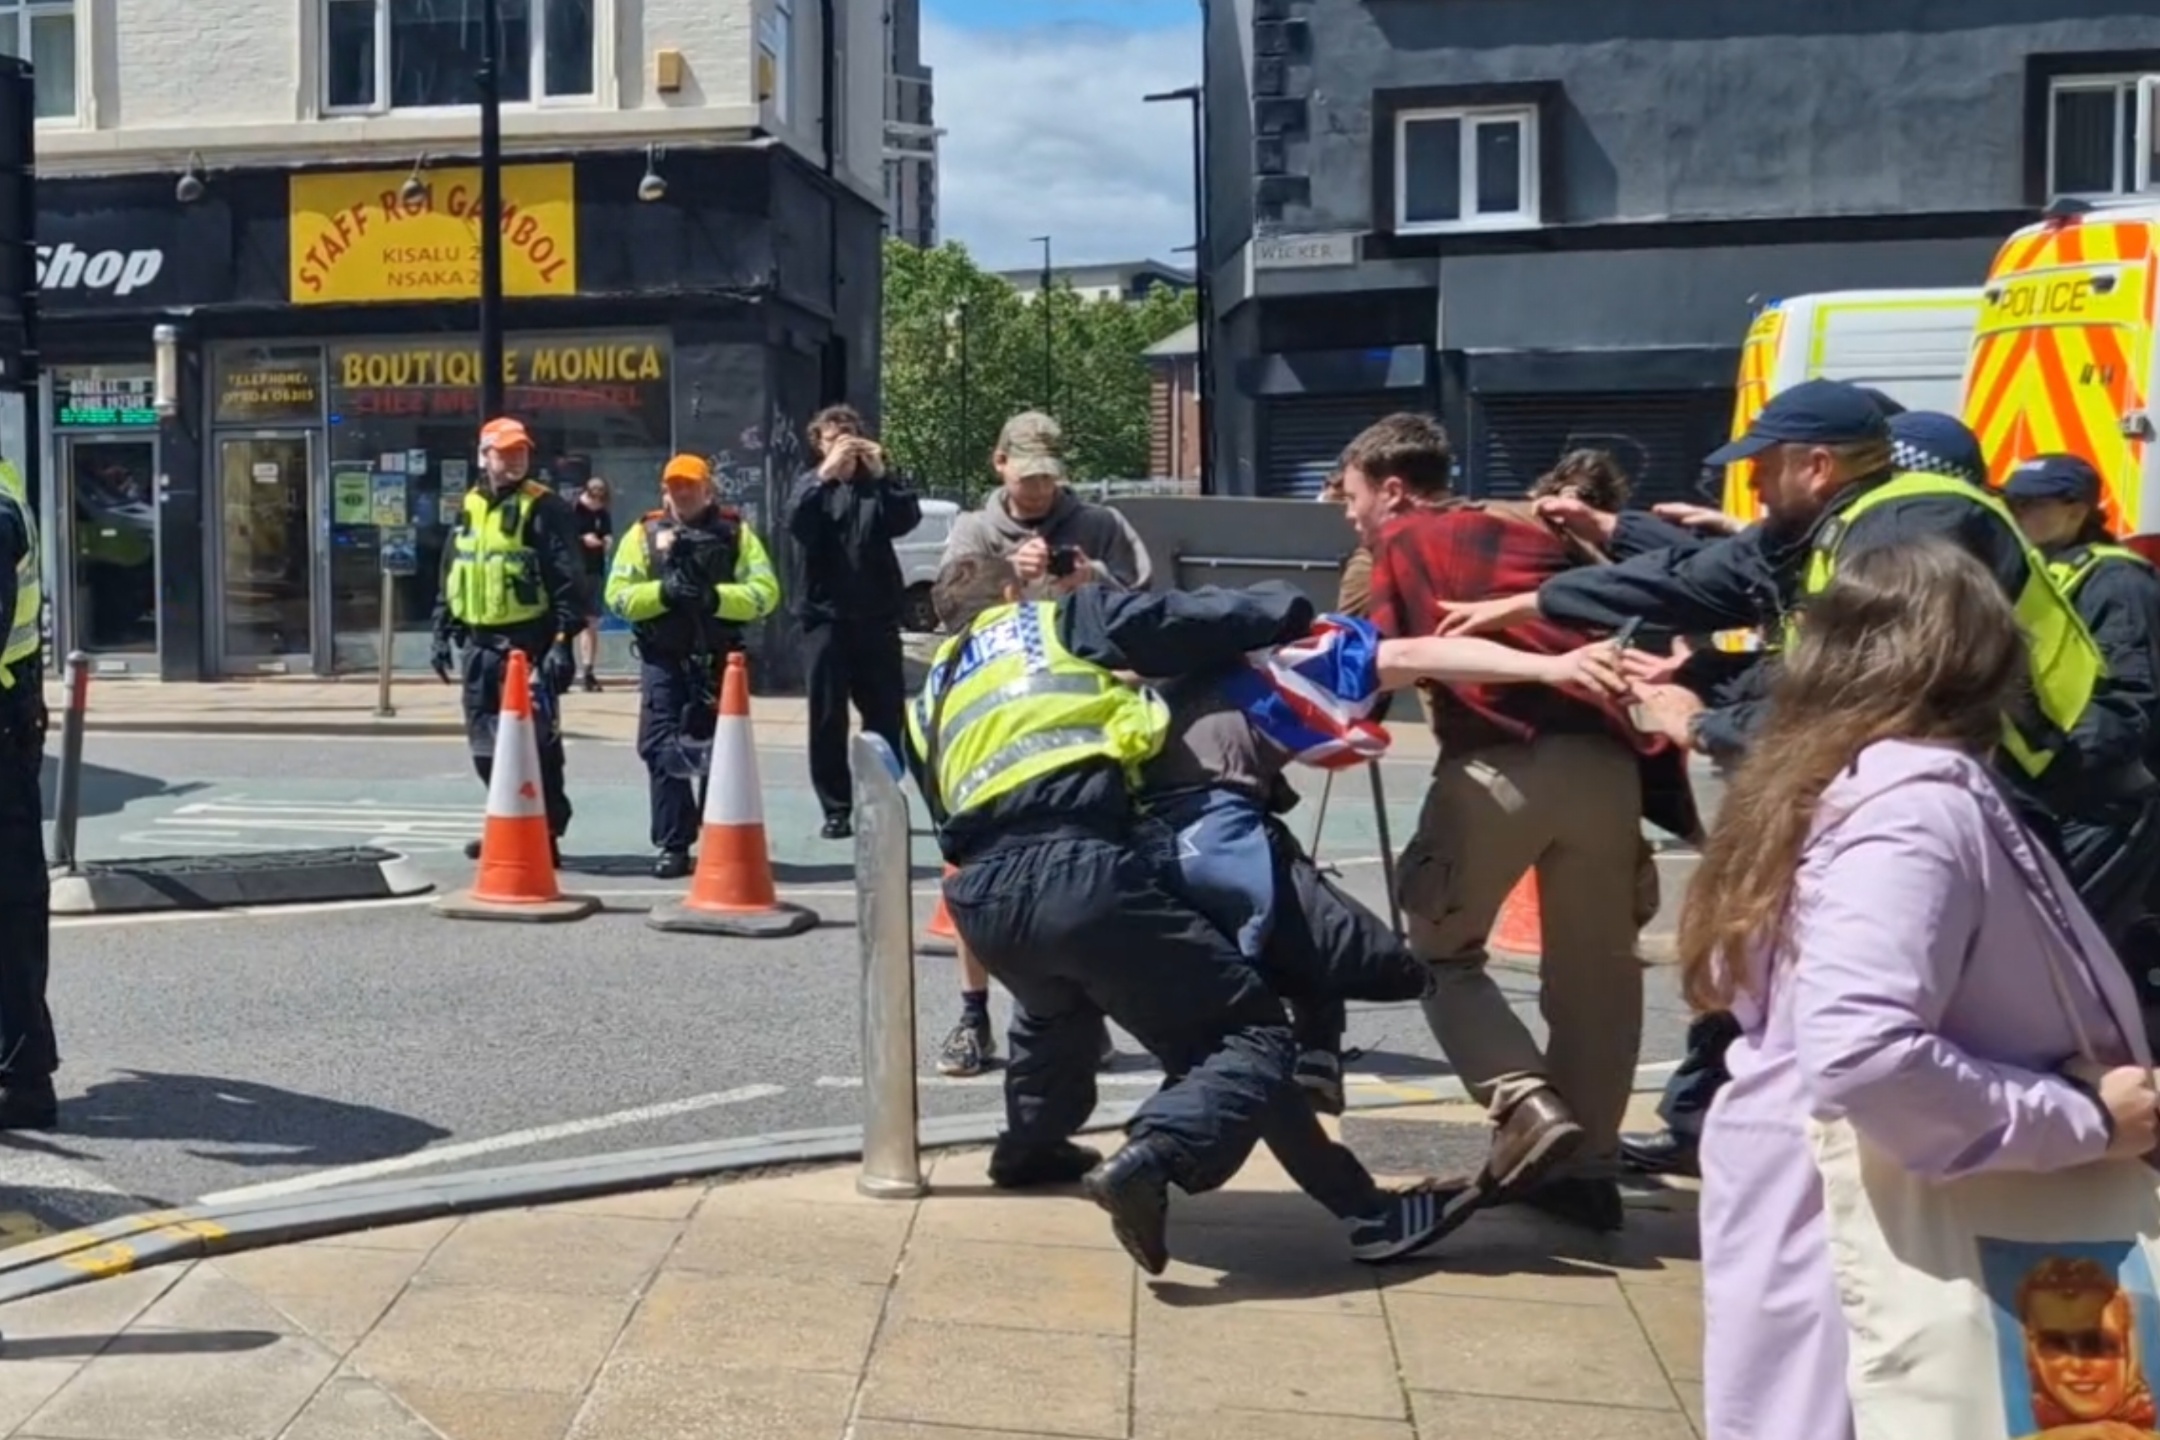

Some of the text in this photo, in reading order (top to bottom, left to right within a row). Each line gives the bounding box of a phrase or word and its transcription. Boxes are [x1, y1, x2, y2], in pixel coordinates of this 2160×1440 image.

[299, 201, 367, 293] STAFF
[383, 245, 460, 265] KISALU
[1261, 243, 1334, 259] WICKER
[388, 270, 464, 287] NSAKA
[1999, 280, 2087, 317] POLICE
[531, 344, 662, 382] MONICA
